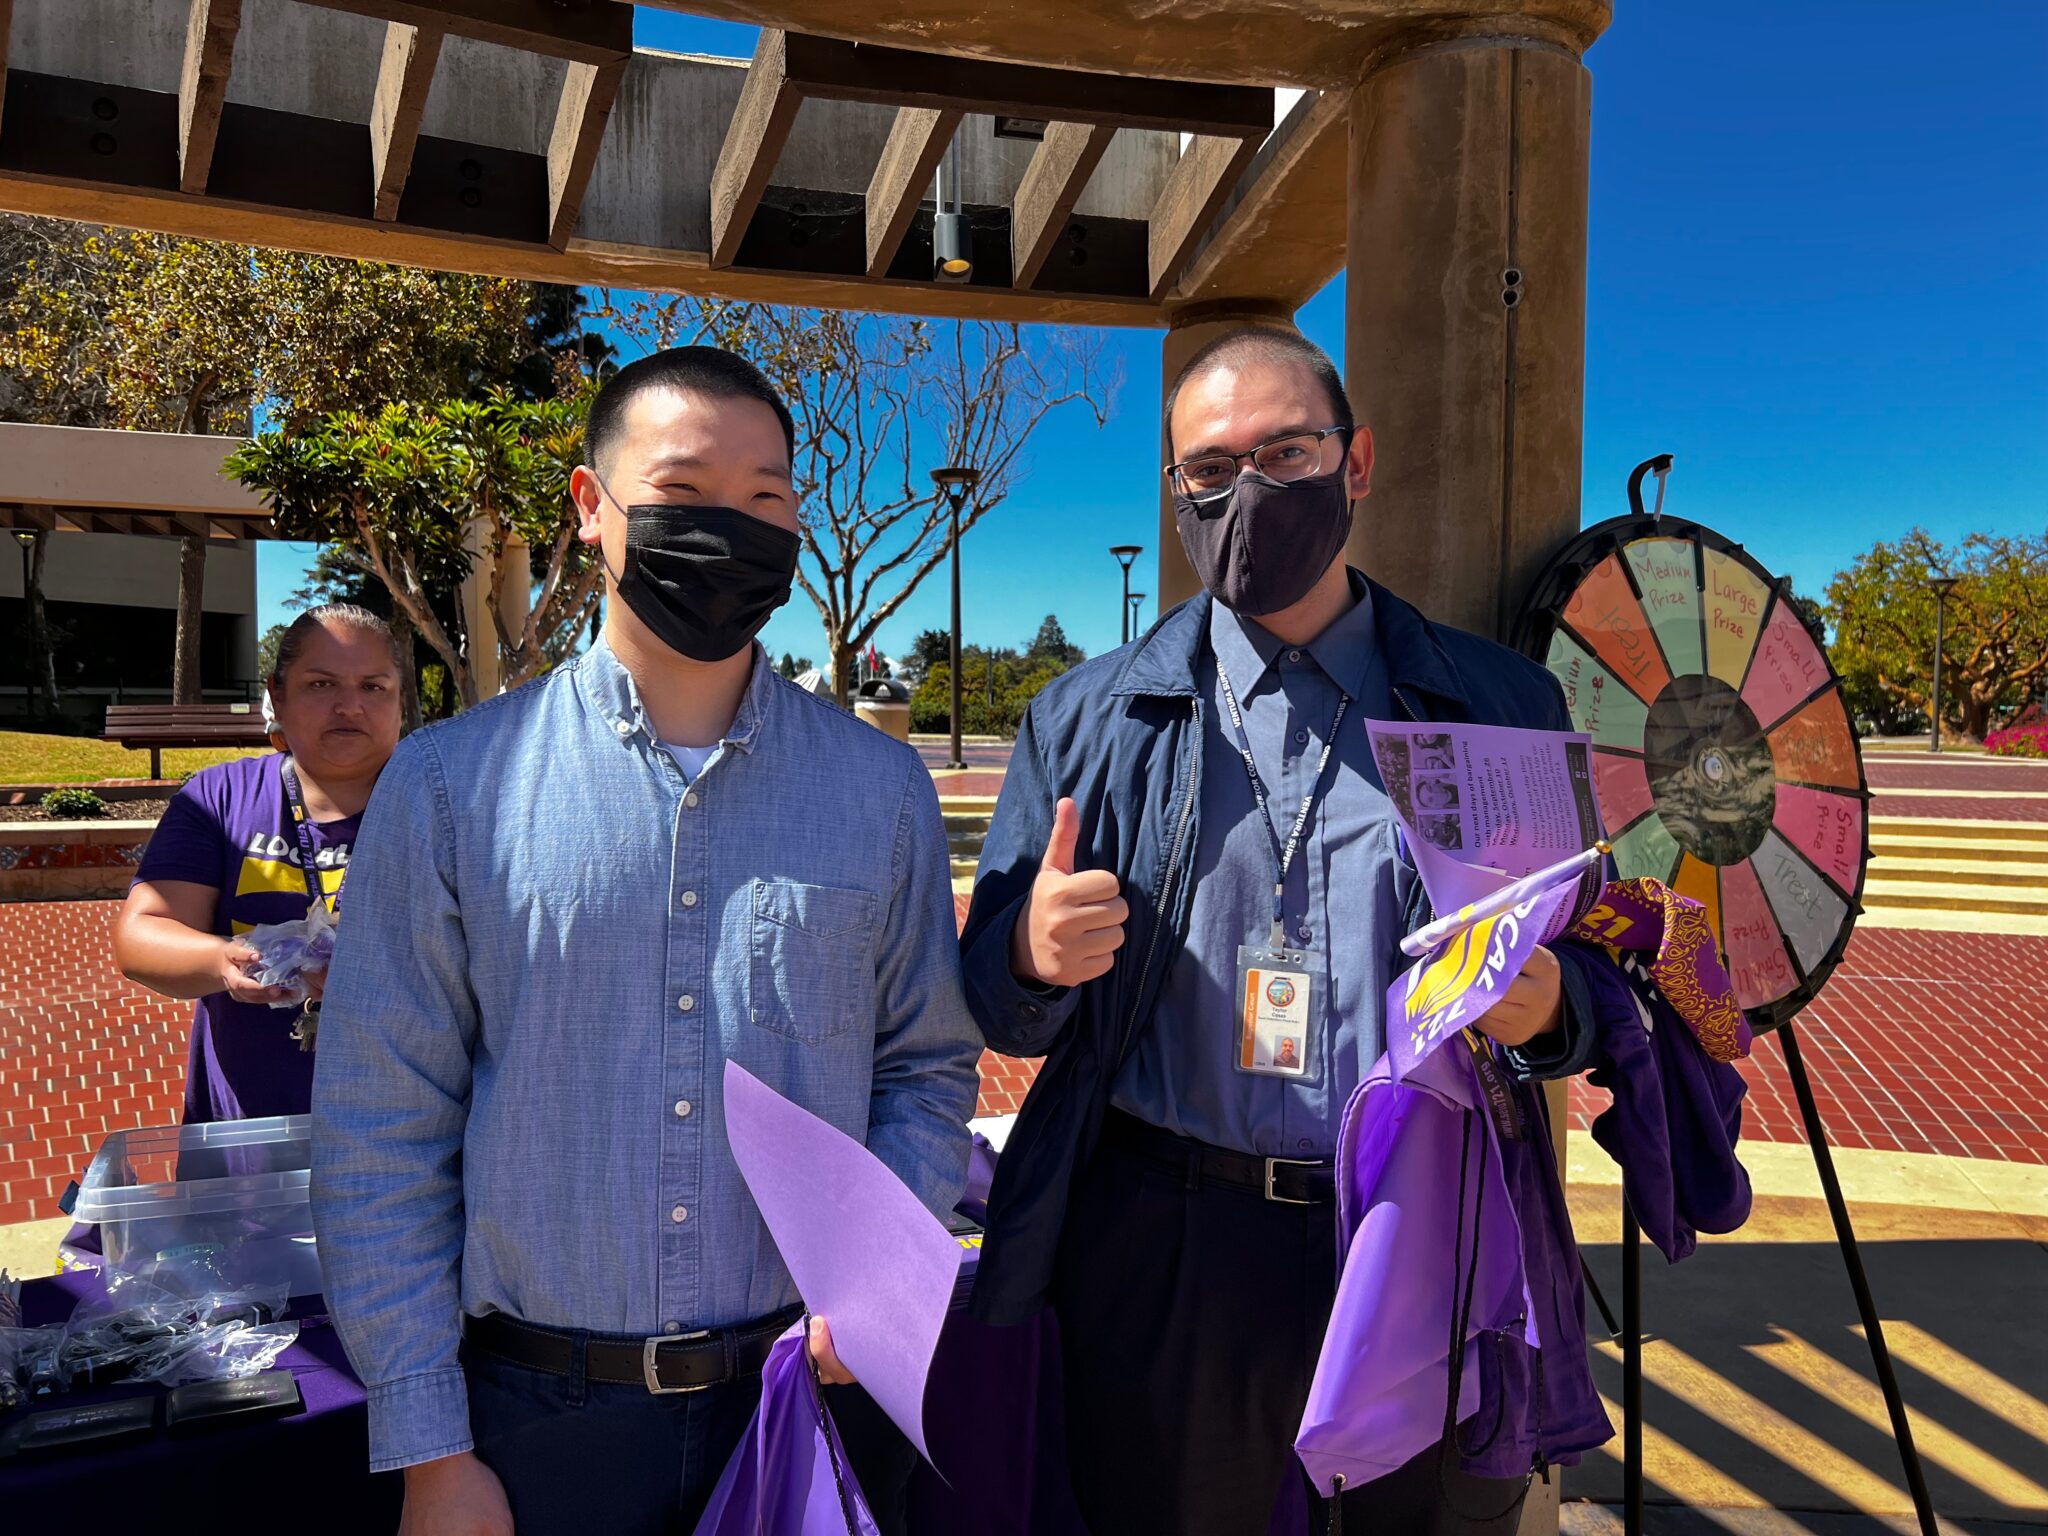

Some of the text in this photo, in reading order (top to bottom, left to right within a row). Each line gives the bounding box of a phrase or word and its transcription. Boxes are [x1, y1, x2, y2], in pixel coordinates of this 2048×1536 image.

[1635, 557, 1692, 582] Medium
[1649, 589, 1687, 611] Prize
[1712, 569, 1758, 615] Large
[1713, 607, 1744, 639] Prize
[1595, 606, 1651, 686] Treat
[1772, 620, 1814, 683] Small
[1764, 644, 1793, 695] Prize
[1224, 688, 1242, 728] VENTURA
[1585, 674, 1604, 732] Prize
[1241, 748, 1256, 780] COURT
[1462, 741, 1473, 781] bargaining
[1526, 756, 1536, 787] yourself
[1534, 757, 1540, 768] Up
[1540, 748, 1548, 764] your
[1468, 783, 1474, 792] of
[1477, 776, 1489, 828] management
[1486, 769, 1498, 810] September
[1495, 769, 1510, 846] Monday, October 10
[1500, 758, 1520, 846] Wednesday, October 12
[1533, 788, 1538, 796] of
[1546, 744, 1568, 848] Worksite Organizer Annette
[1292, 795, 1313, 838] VENTURA
[1472, 814, 1480, 831] next
[1492, 813, 1501, 846] Monday,
[1530, 809, 1537, 820] Up
[1536, 799, 1545, 822] photo
[1544, 802, 1552, 820] your
[1813, 805, 1830, 851] Prize
[298, 823, 316, 870] SEIU 721
[1532, 822, 1540, 848] Purple
[1832, 806, 1853, 878] Small
[1774, 853, 1823, 920] Treat
[1732, 915, 1770, 942] Prize
[1414, 893, 1541, 1056] OCAL 721
